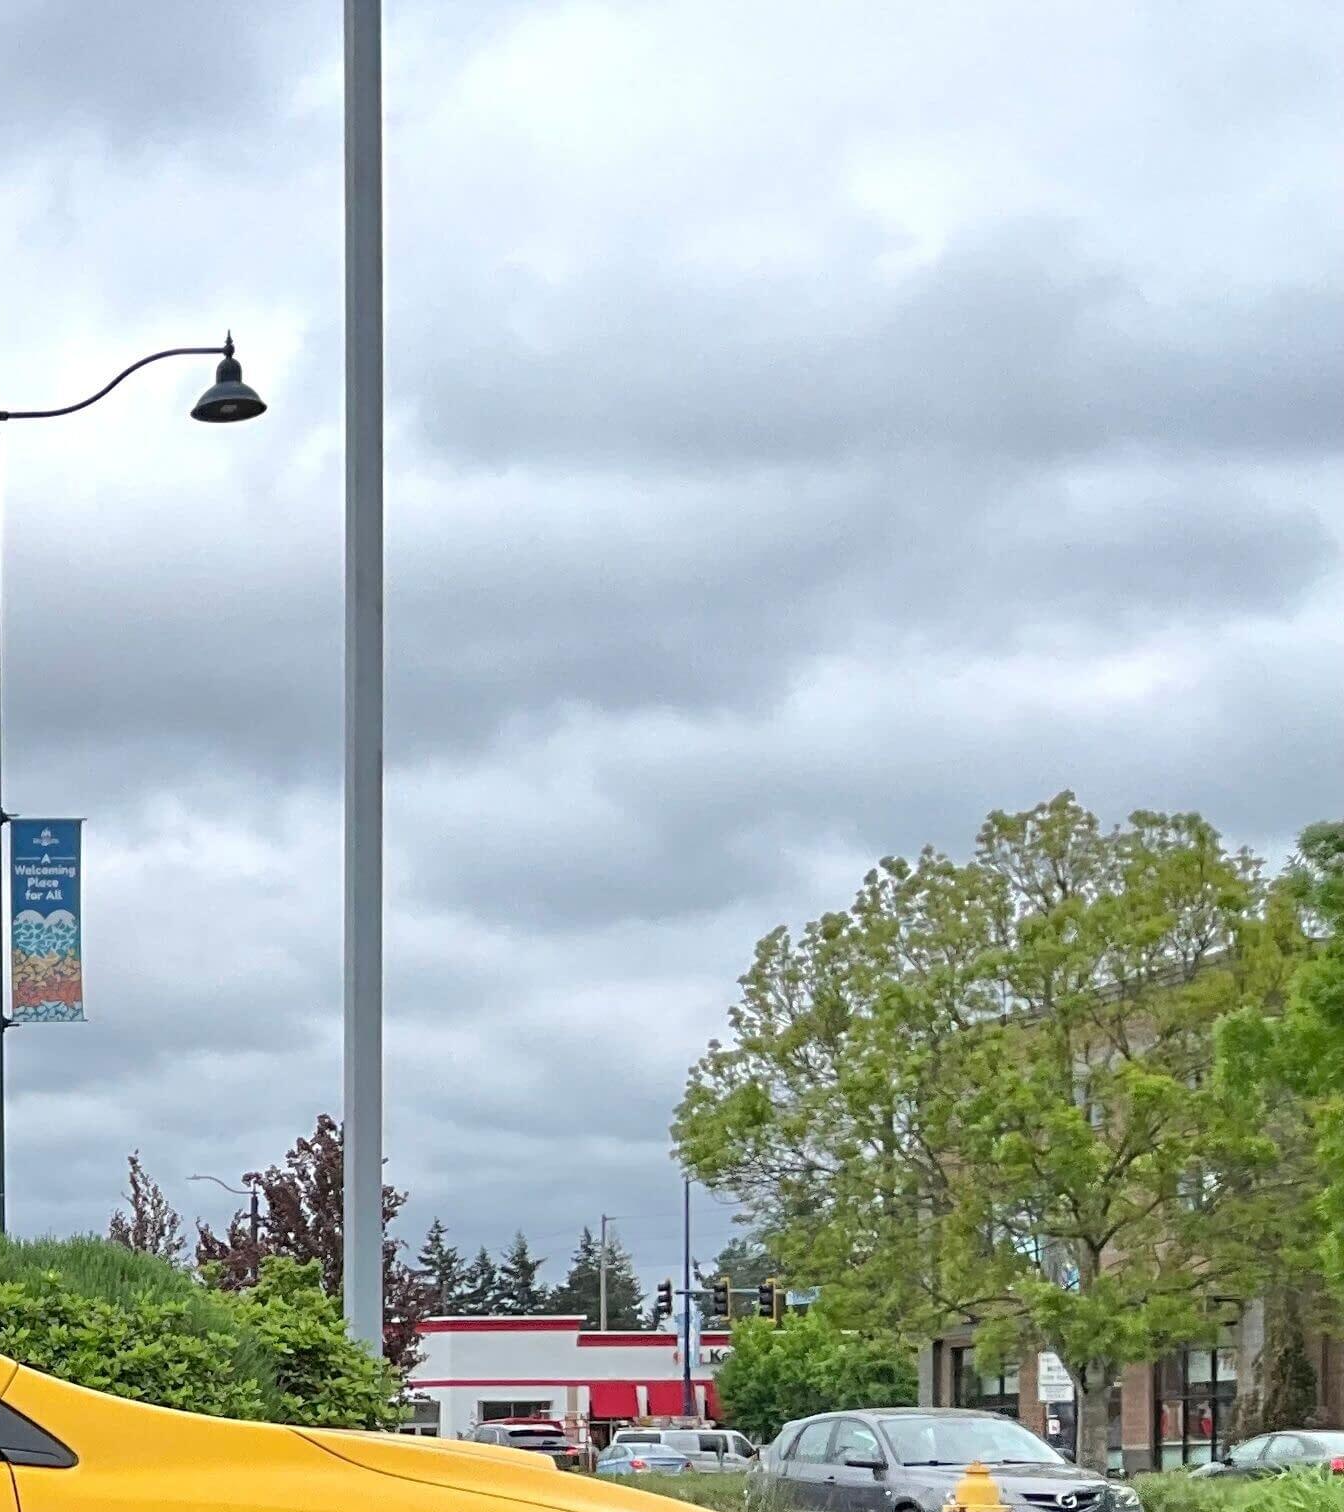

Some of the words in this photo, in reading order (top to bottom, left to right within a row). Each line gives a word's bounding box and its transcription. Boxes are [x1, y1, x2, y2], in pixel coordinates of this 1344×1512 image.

[41, 853, 51, 864] A
[15, 865, 76, 878] Welcoming
[27, 877, 59, 888] Place
[25, 889, 43, 901] for
